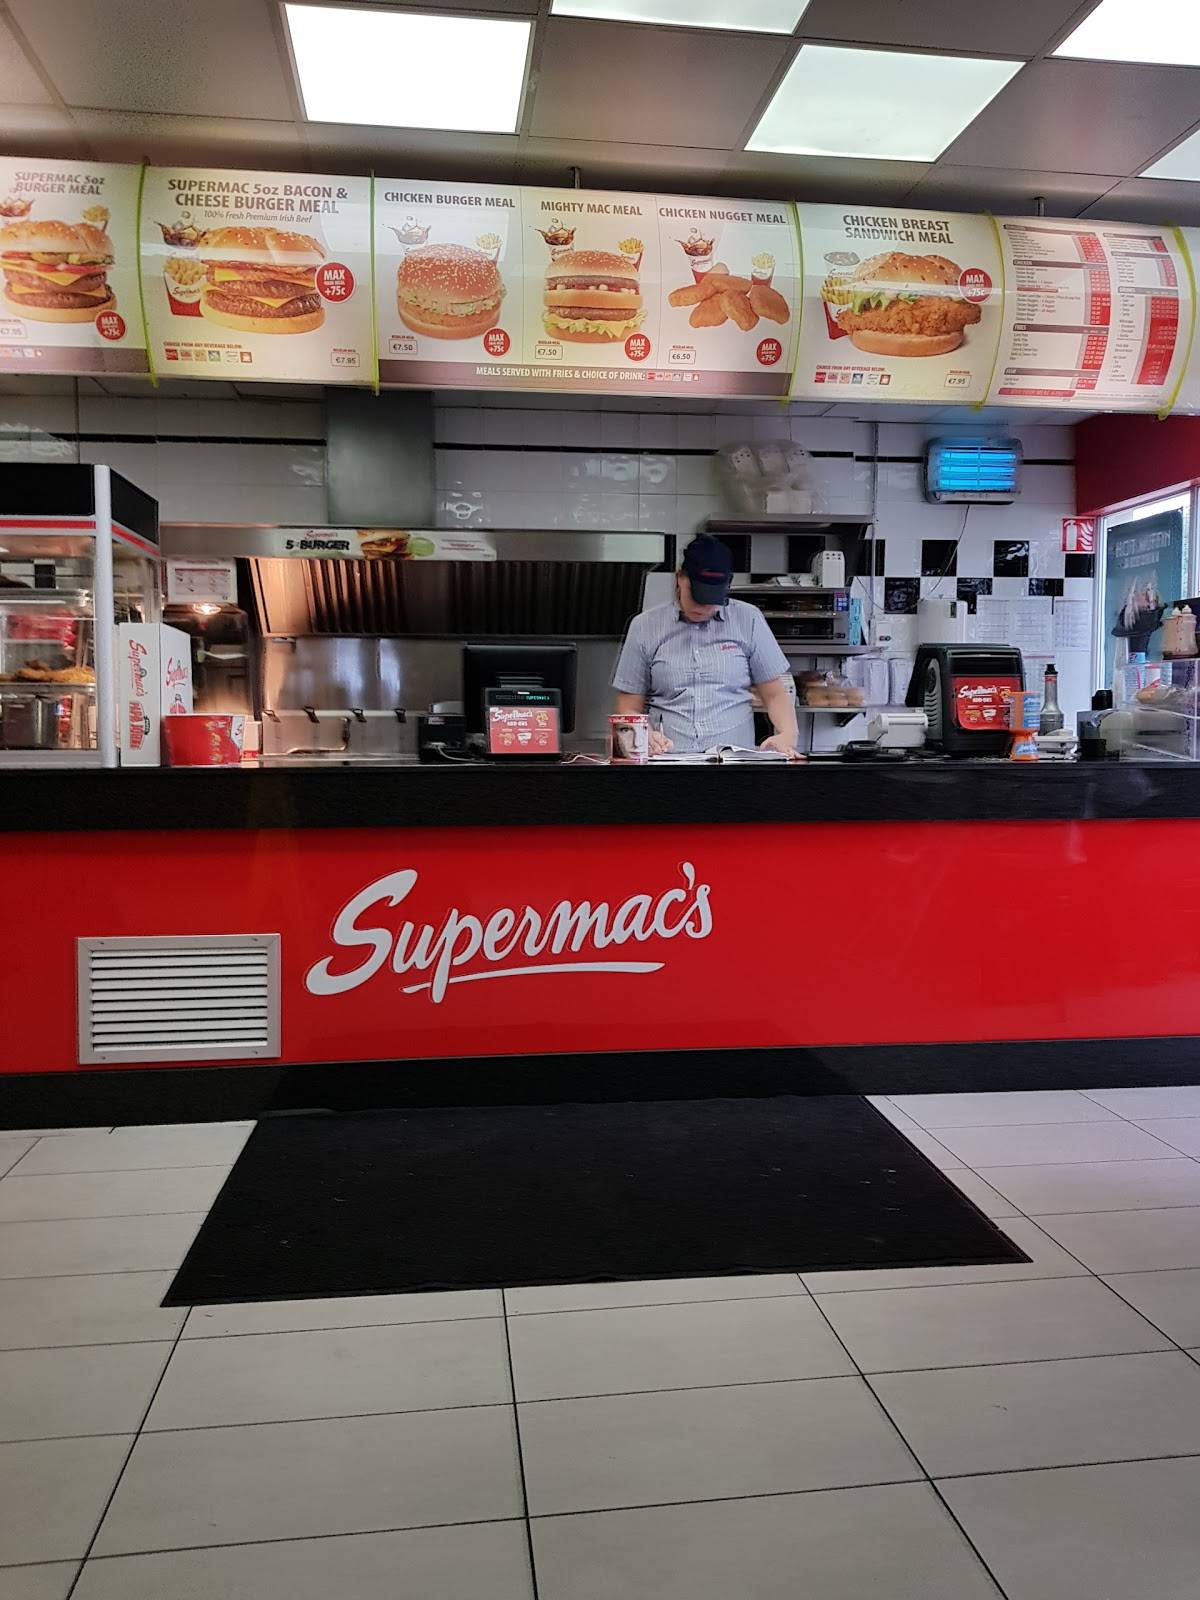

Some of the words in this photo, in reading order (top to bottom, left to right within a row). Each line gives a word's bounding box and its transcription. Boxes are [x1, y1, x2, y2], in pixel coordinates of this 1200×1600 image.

[14, 171, 81, 184] SUPERMAC
[15, 181, 65, 194] BURGER
[68, 184, 102, 195] MEAL
[167, 179, 250, 194] SUPERMAC
[253, 183, 279, 196] 5oz
[283, 184, 333, 198] BACON
[336, 187, 348, 199] &
[175, 193, 230, 208] CHEESE
[234, 196, 295, 212] BURGER
[299, 199, 339, 214] MEAL
[384, 191, 433, 204] CHICKEN
[436, 194, 482, 207] BURGER
[484, 197, 516, 208] MEAL
[540, 201, 585, 213] MIGHTY
[587, 203, 612, 214] MAC
[613, 204, 643, 216] MEAL
[659, 207, 706, 219] CHICKEN
[709, 210, 753, 222] NUGGET
[756, 213, 787, 224] MEAL
[225, 211, 245, 220] Fresh
[246, 213, 278, 222] Premium
[279, 213, 295, 222] Irish
[296, 215, 313, 224] Beef
[843, 214, 898, 229] CHICKEN
[901, 218, 950, 231] BREAST
[845, 227, 915, 243] SANDWICH
[918, 231, 954, 244] MEAL
[323, 269, 345, 281] MAX
[966, 273, 985, 284] MAX
[393, 343, 413, 351] €7.50
[629, 338, 646, 347] MAX
[761, 343, 777, 351] MAX
[537, 348, 557, 356] €7.50
[476, 366, 501, 376] MEALS
[502, 367, 530, 377] SERVED
[531, 368, 551, 378] WITH
[552, 370, 573, 379] FRIES
[574, 370, 580, 379] &
[581, 370, 608, 380] CHOICE
[609, 371, 618, 380] OF
[299, 539, 350, 551] BURGER
[305, 861, 713, 1004] Supermac's
